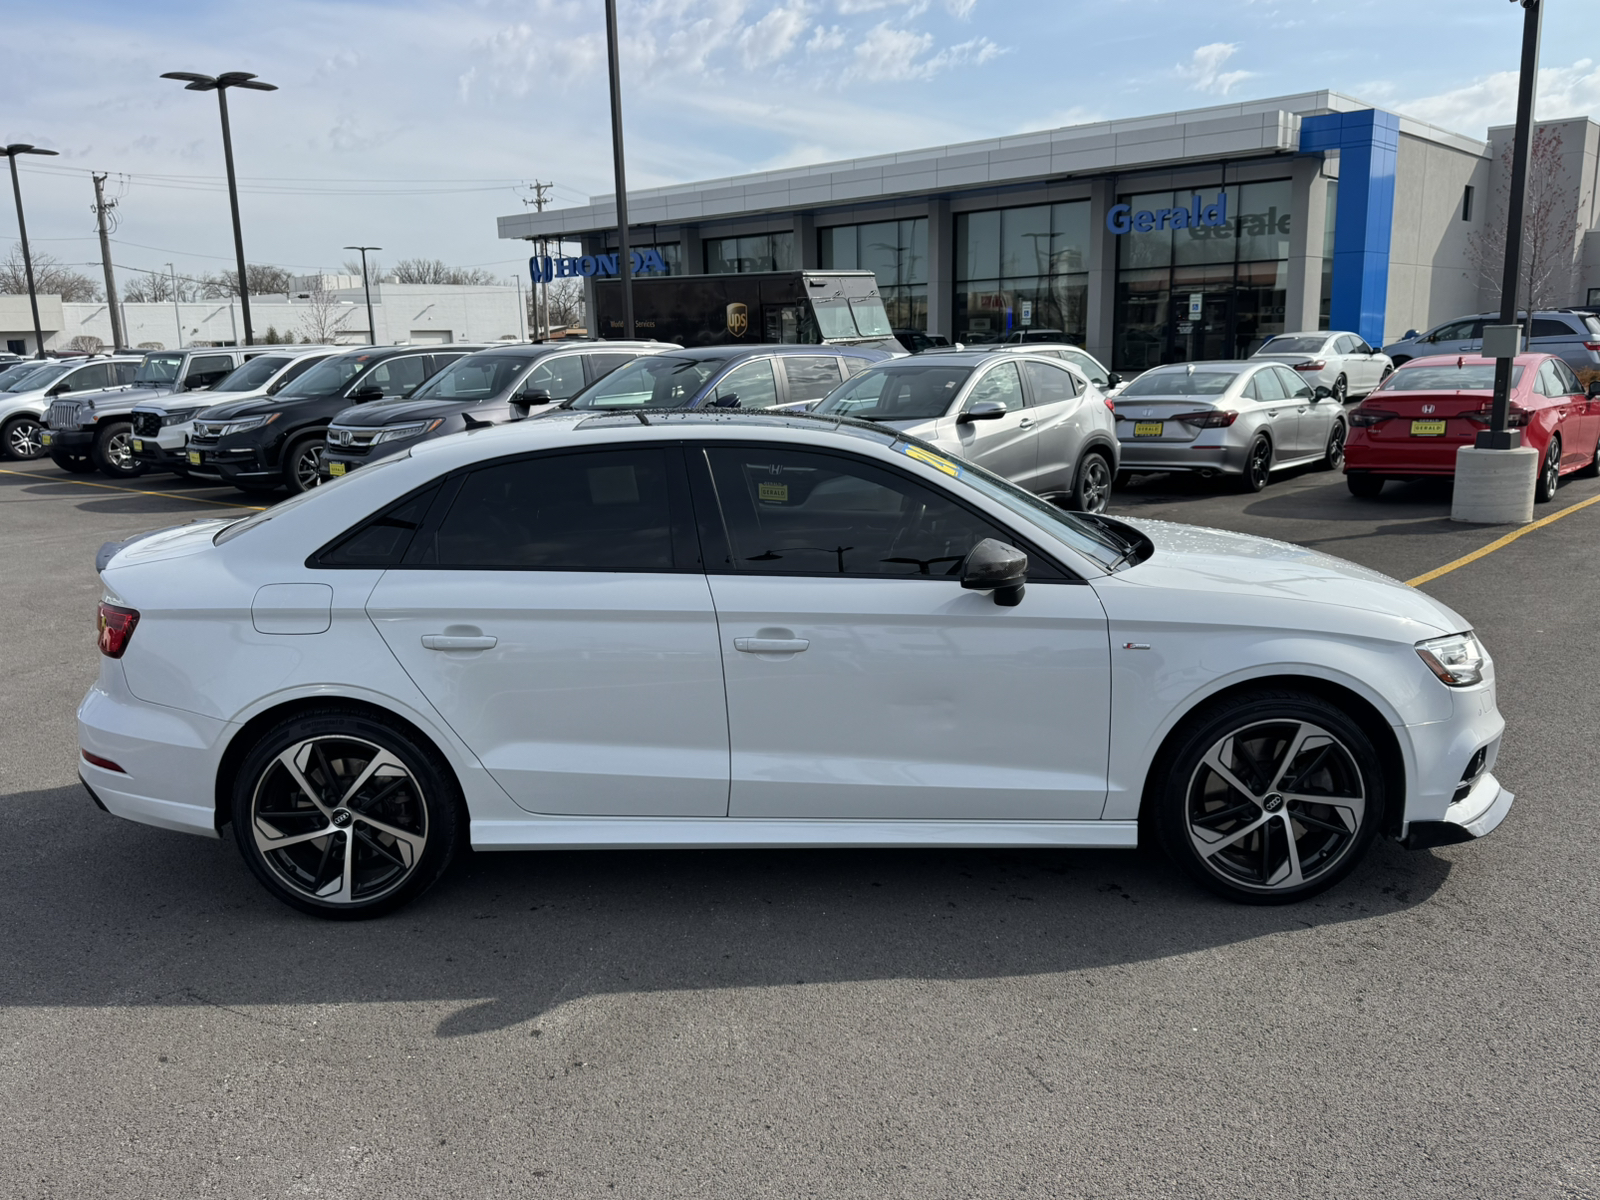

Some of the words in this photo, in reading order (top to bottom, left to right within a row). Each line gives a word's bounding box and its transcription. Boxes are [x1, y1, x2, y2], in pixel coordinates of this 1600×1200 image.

[1106, 192, 1227, 235] Gerald
[554, 249, 667, 278] HONDA
[635, 320, 655, 328] Services
[728, 313, 746, 332] ups
